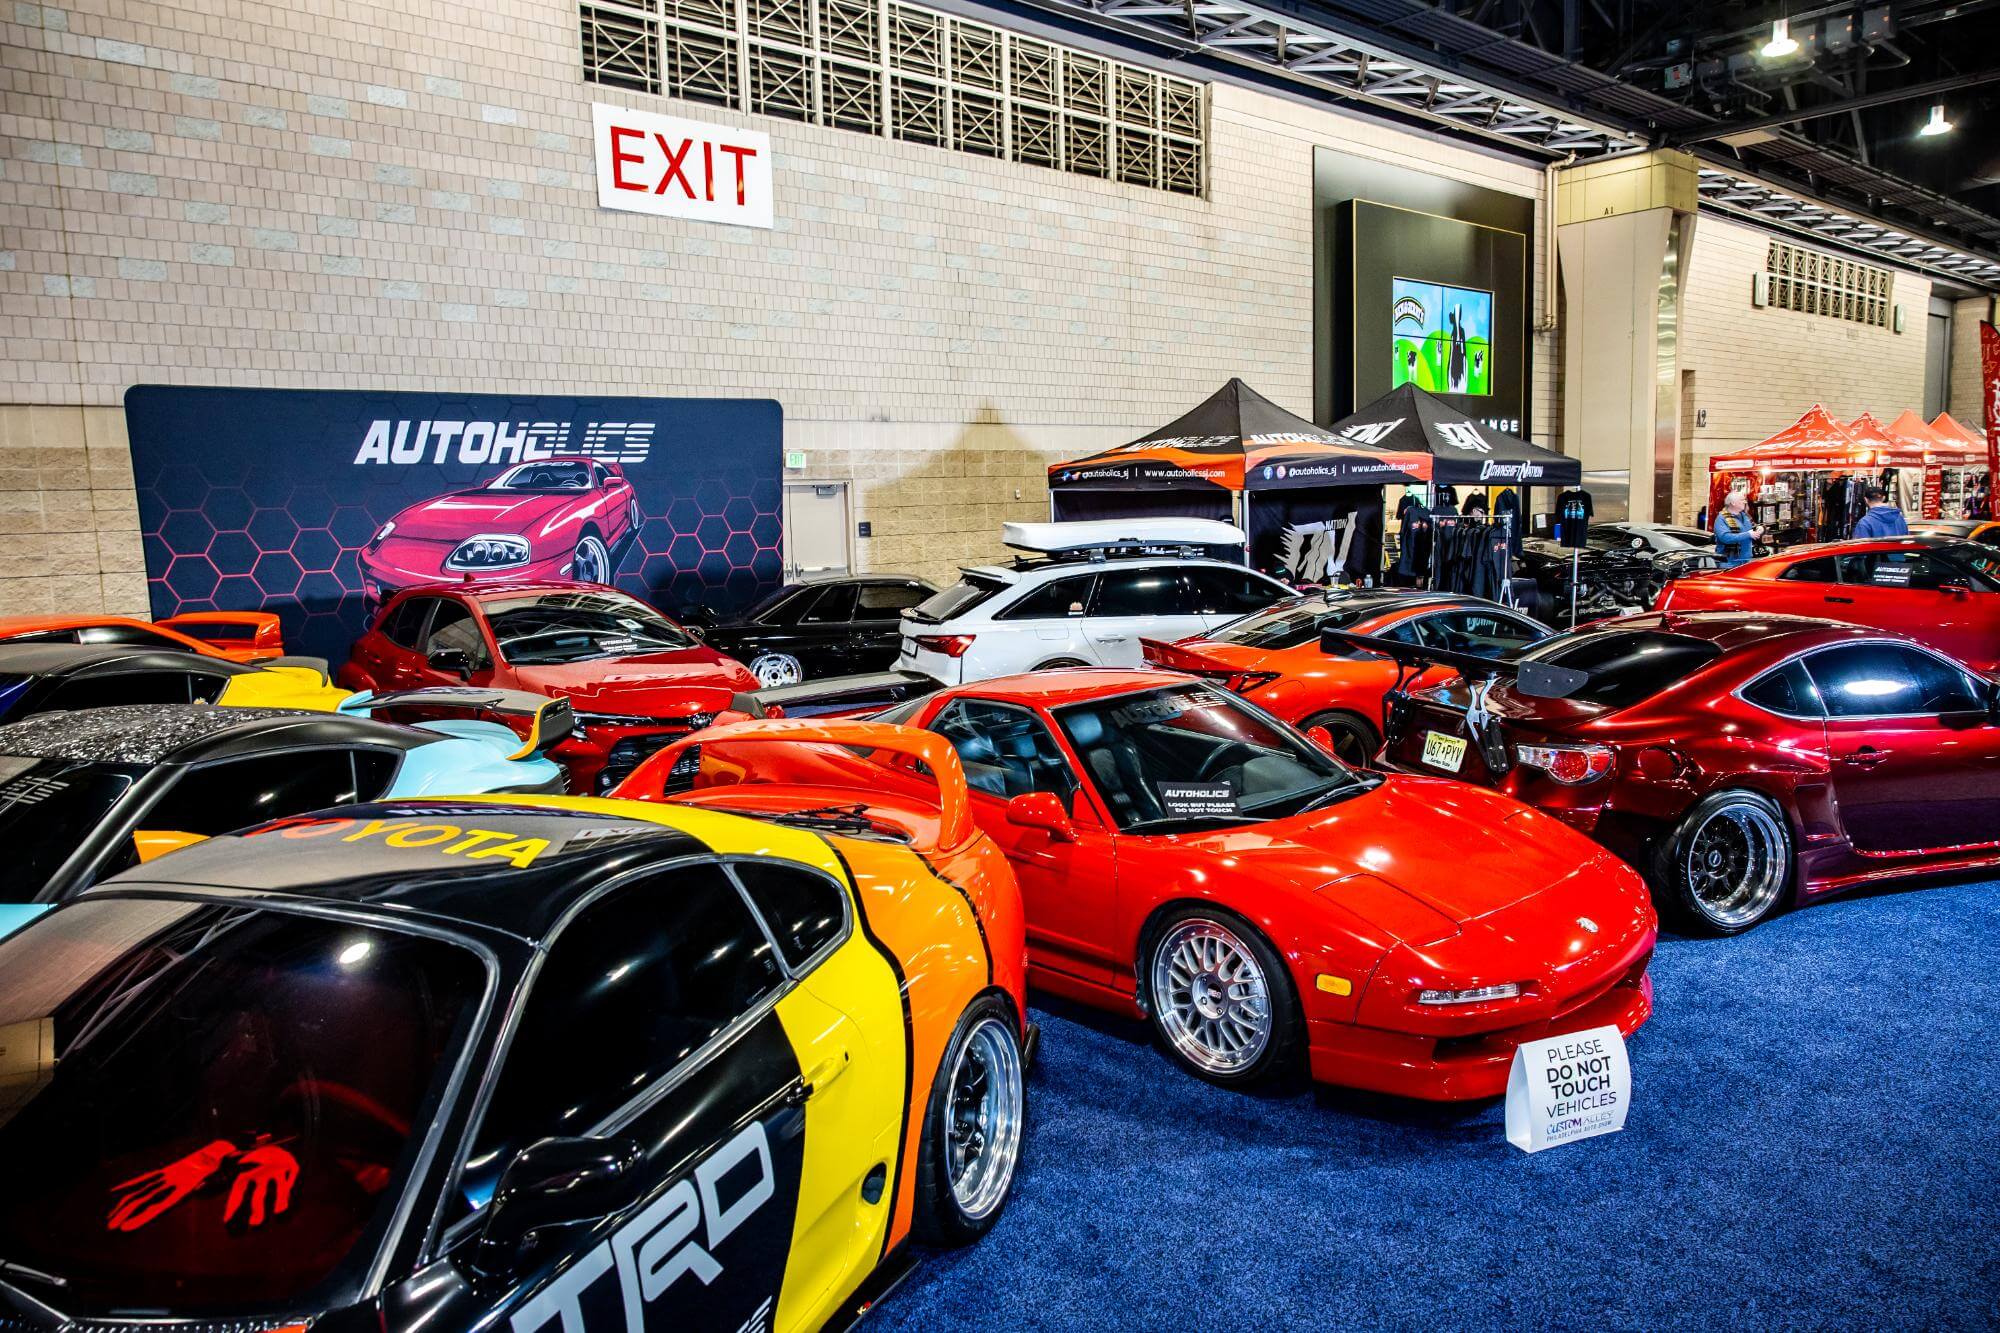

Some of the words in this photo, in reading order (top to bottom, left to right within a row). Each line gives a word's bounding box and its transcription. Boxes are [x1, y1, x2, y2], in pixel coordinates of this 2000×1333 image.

[611, 126, 757, 206] EXIT
[353, 420, 655, 464] AUTOHOLICS
[1145, 469, 1226, 481] www.autoholicssj.com
[1165, 789, 1230, 798] AUTOHOLICS
[243, 818, 551, 868] TOYOTA
[1547, 1039, 1604, 1063] PLEASE
[1546, 1065, 1573, 1084] DO
[1577, 1056, 1611, 1076] NOT
[1551, 1075, 1611, 1099] TOUCH
[1546, 1091, 1617, 1118] VEHICLES
[1583, 1110, 1615, 1125] ALLEY
[509, 1120, 775, 1333] TRD
